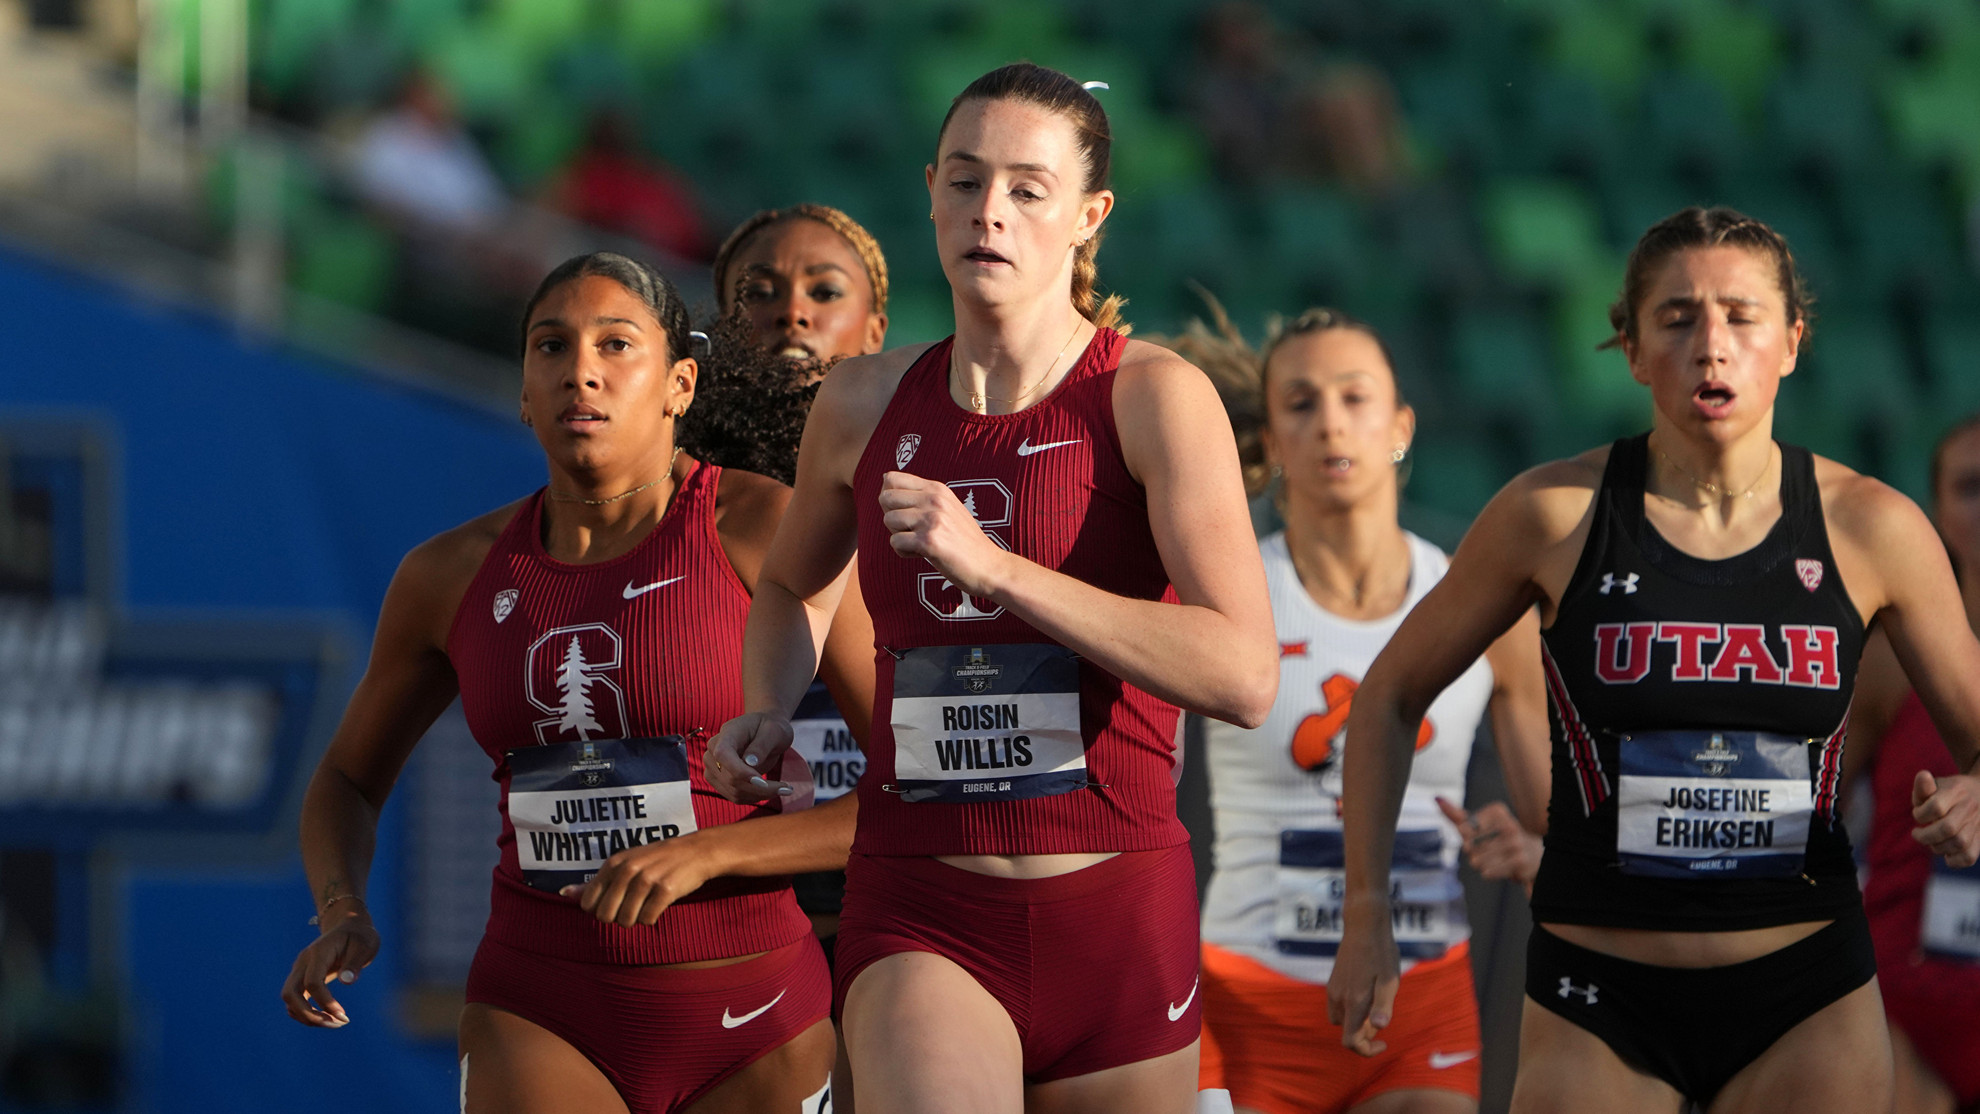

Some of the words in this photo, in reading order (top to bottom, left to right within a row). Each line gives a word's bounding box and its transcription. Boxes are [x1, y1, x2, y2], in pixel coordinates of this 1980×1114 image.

[1594, 621, 1840, 690] UTAH
[956, 668, 999, 677] CHAMPIONSHIPS
[943, 703, 1019, 731] ROISIN
[934, 735, 1033, 771] WILLIS
[963, 782, 997, 793] EUGENE,
[998, 781, 1011, 791] OR
[1663, 787, 1771, 813] JOSEFINE
[550, 794, 648, 825] JULIETTE
[1656, 817, 1775, 849] ERIKSEN
